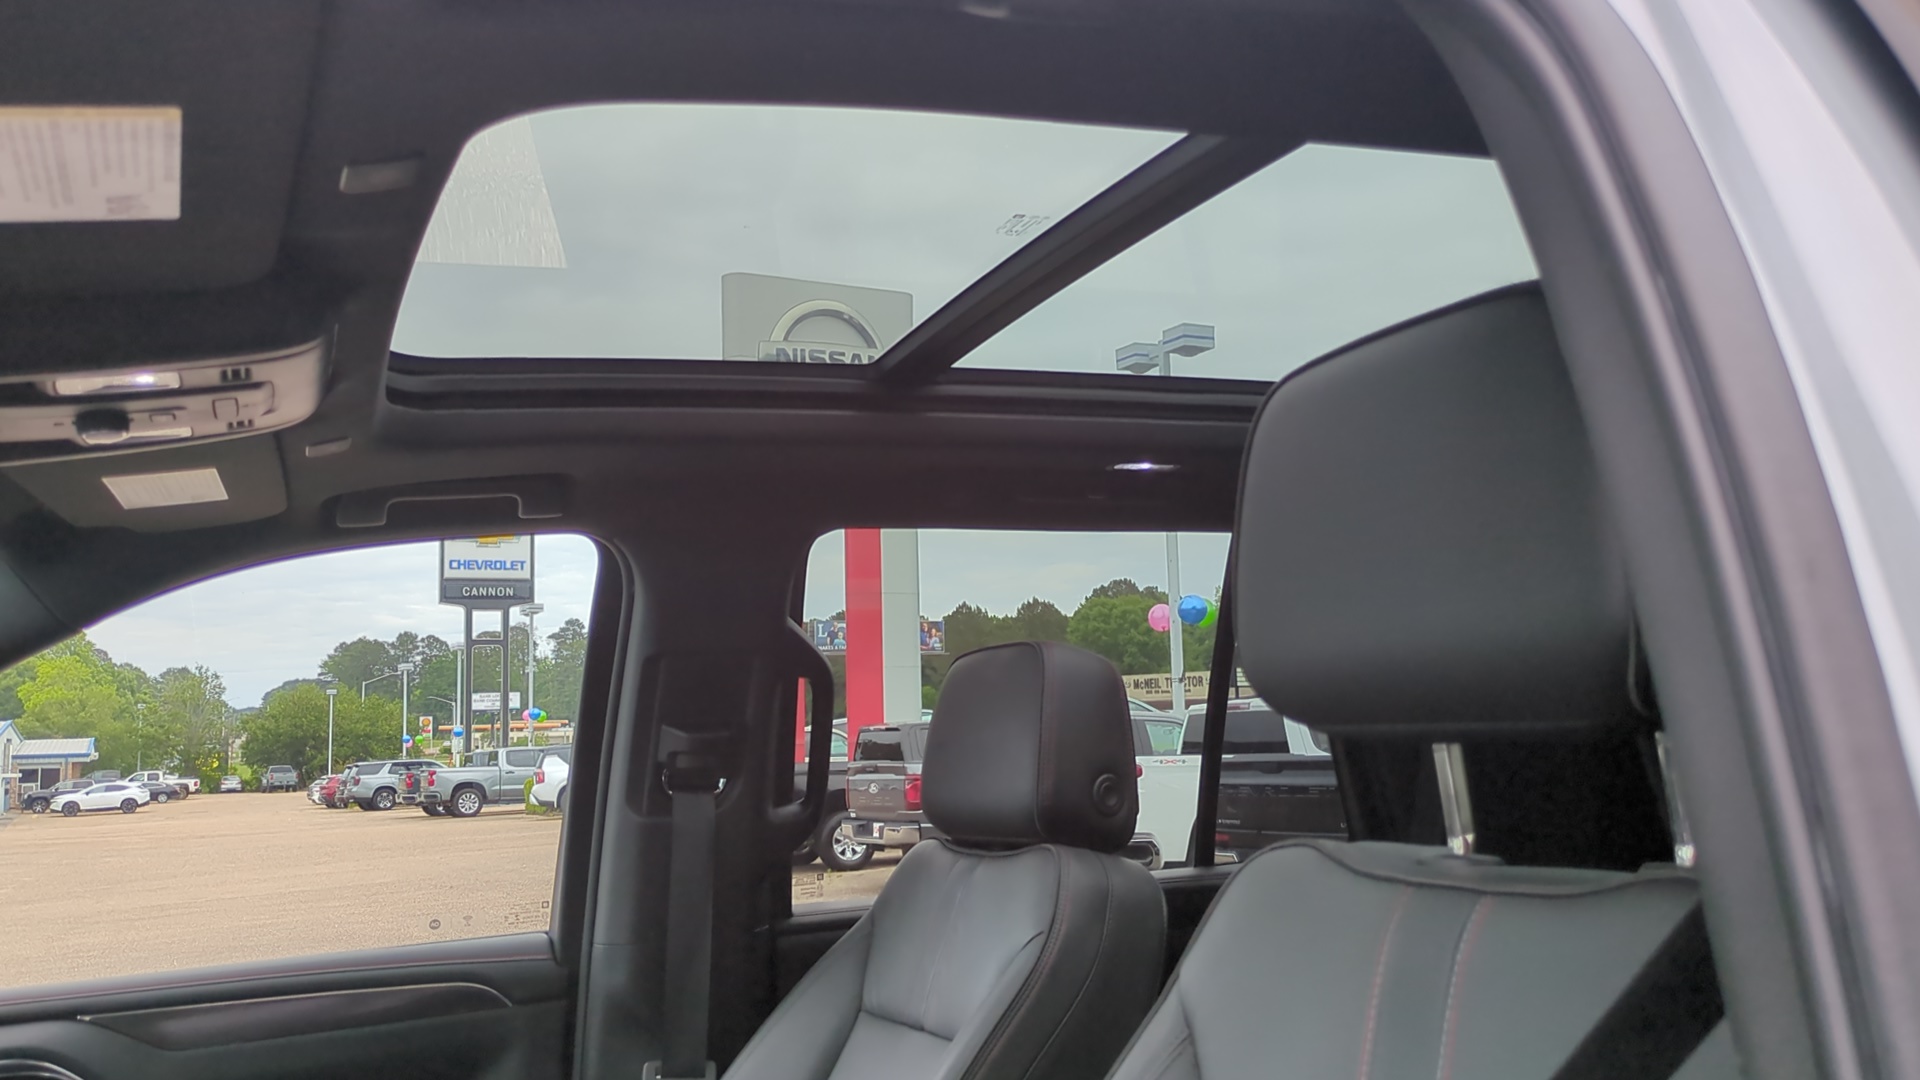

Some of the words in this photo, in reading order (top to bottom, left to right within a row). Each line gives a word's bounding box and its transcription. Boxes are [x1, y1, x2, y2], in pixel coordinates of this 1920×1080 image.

[449, 559, 526, 571] CHEVROLET
[462, 586, 514, 597] CANNON
[1133, 677, 1161, 690] McNEIL
